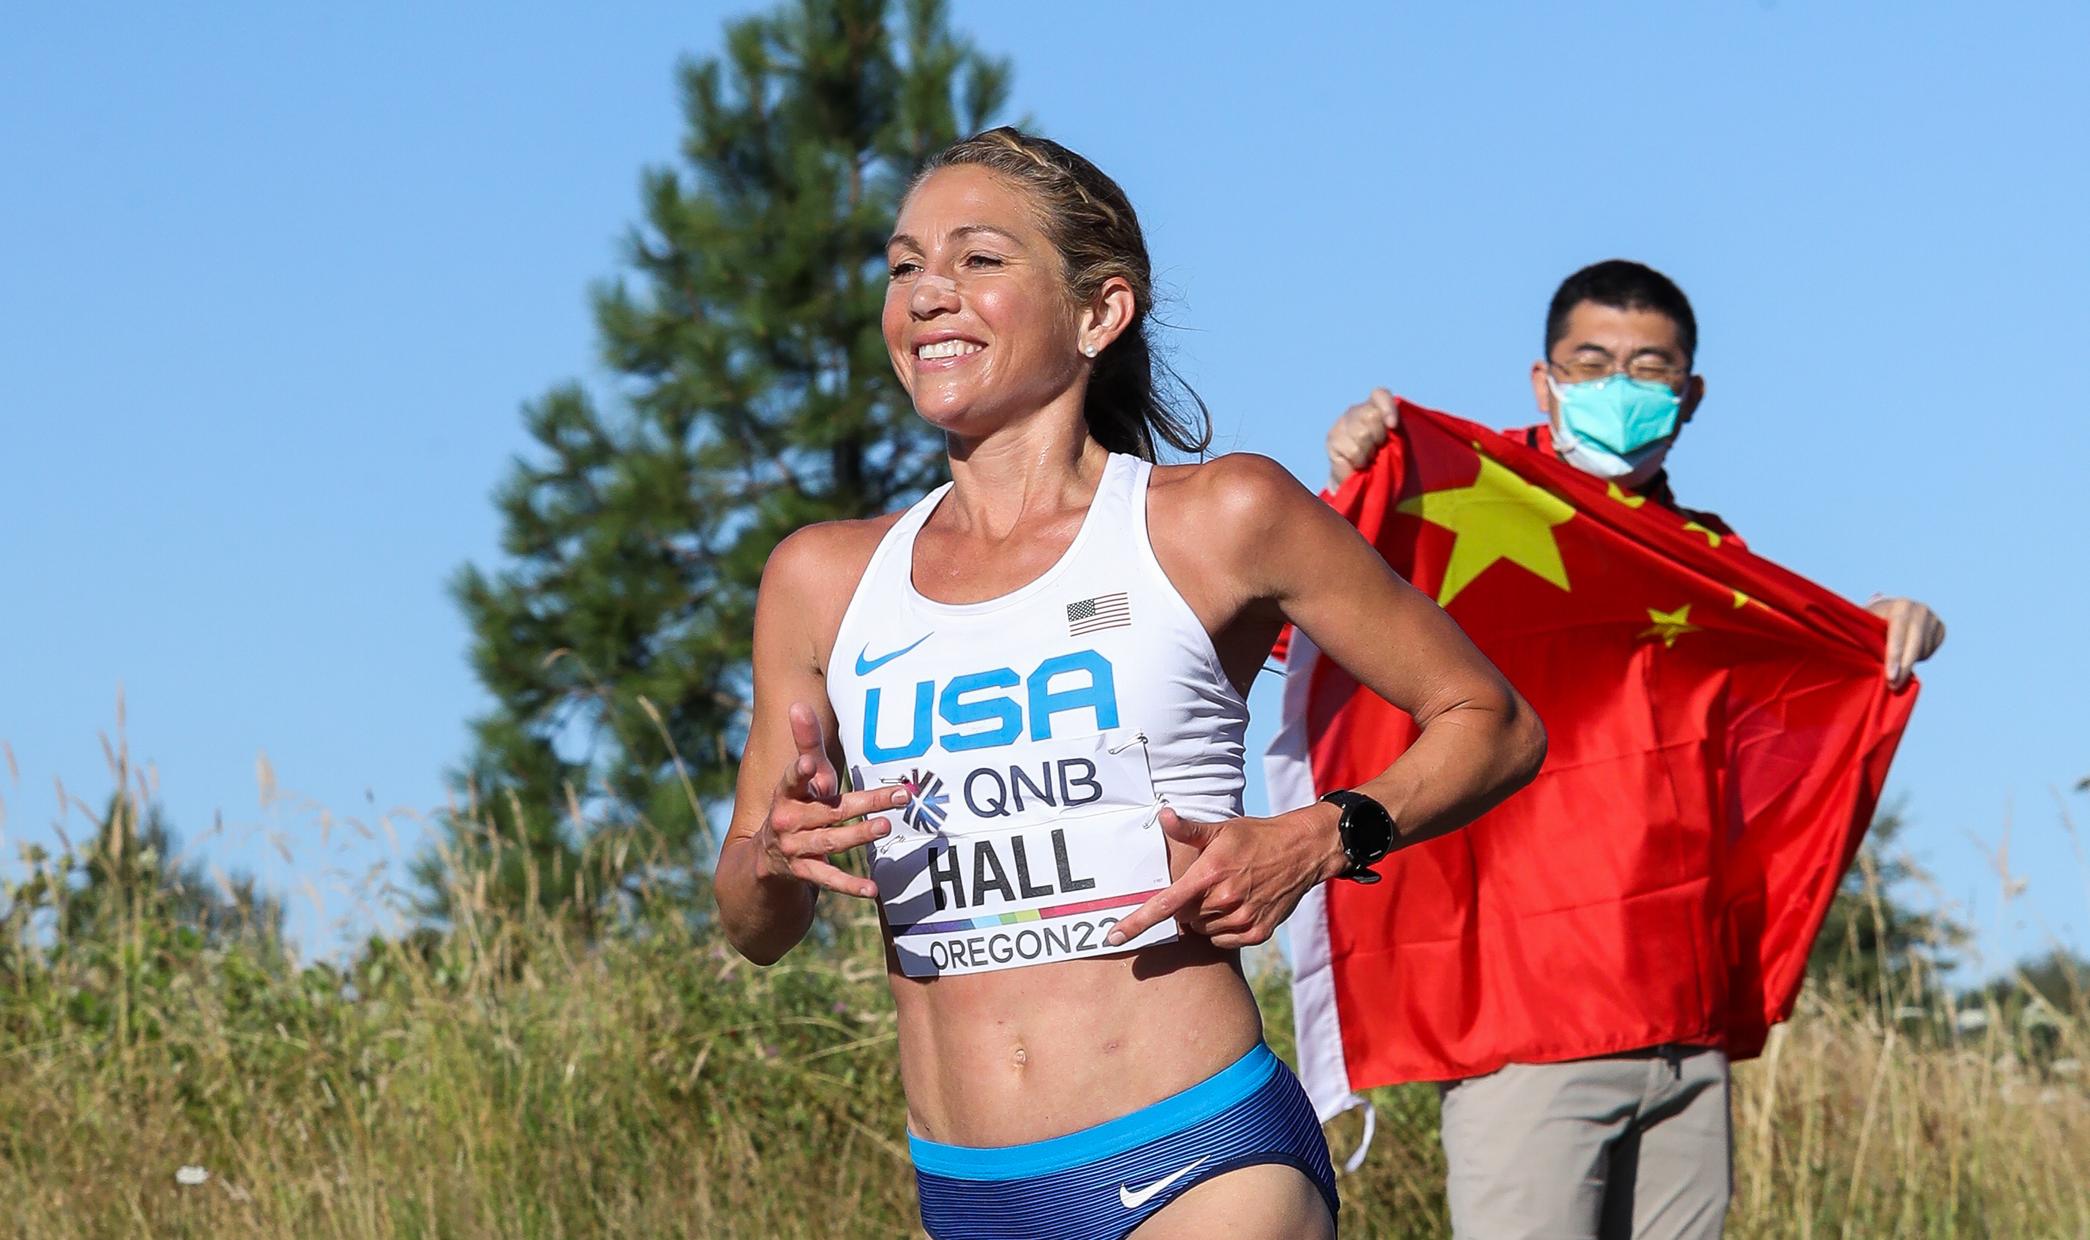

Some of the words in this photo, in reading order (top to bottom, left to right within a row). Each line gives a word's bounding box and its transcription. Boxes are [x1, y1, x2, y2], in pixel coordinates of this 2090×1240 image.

[864, 650, 1119, 764] USA
[964, 758, 1102, 818] QNB
[929, 829, 1095, 911] HALL
